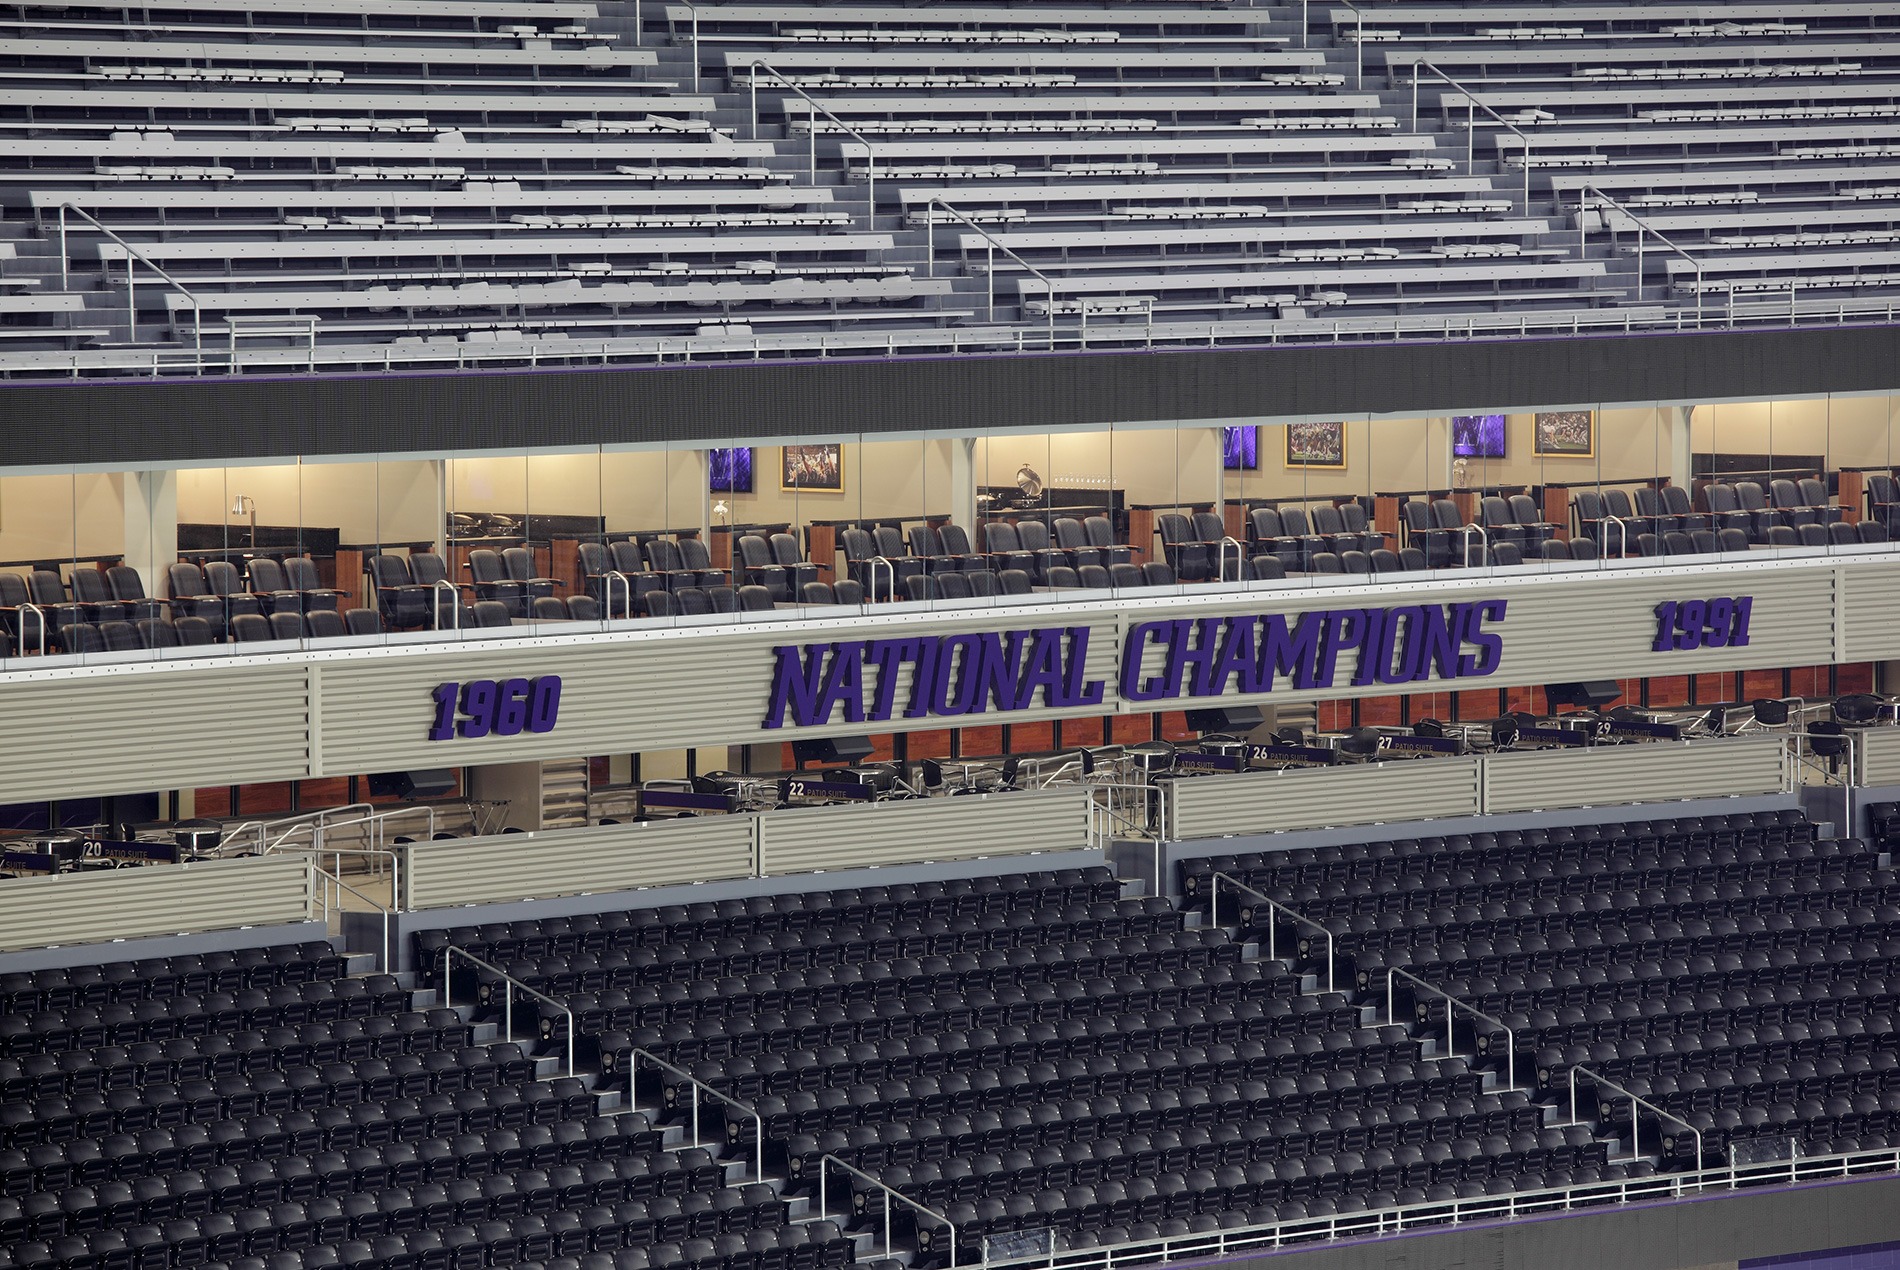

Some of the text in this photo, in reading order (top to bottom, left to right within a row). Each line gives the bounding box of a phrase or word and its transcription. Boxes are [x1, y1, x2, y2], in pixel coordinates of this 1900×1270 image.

[1653, 596, 1752, 652] 1991
[762, 600, 1508, 730] NATIONAL CHAMPIONS
[429, 675, 562, 740] 1960
[1597, 722, 1652, 737] 29 PATIO SUITE
[1378, 736, 1392, 749] 27
[1522, 734, 1541, 742] PATIO
[1543, 735, 1560, 743] SUITE
[1253, 746, 1309, 761] 26 PATIO SUITE
[1196, 761, 1215, 769] SUITE
[789, 782, 847, 798] 22 PATIO SUITE
[85, 841, 148, 859] 20 PATIO SUITE
[6, 860, 27, 870] SUITE
